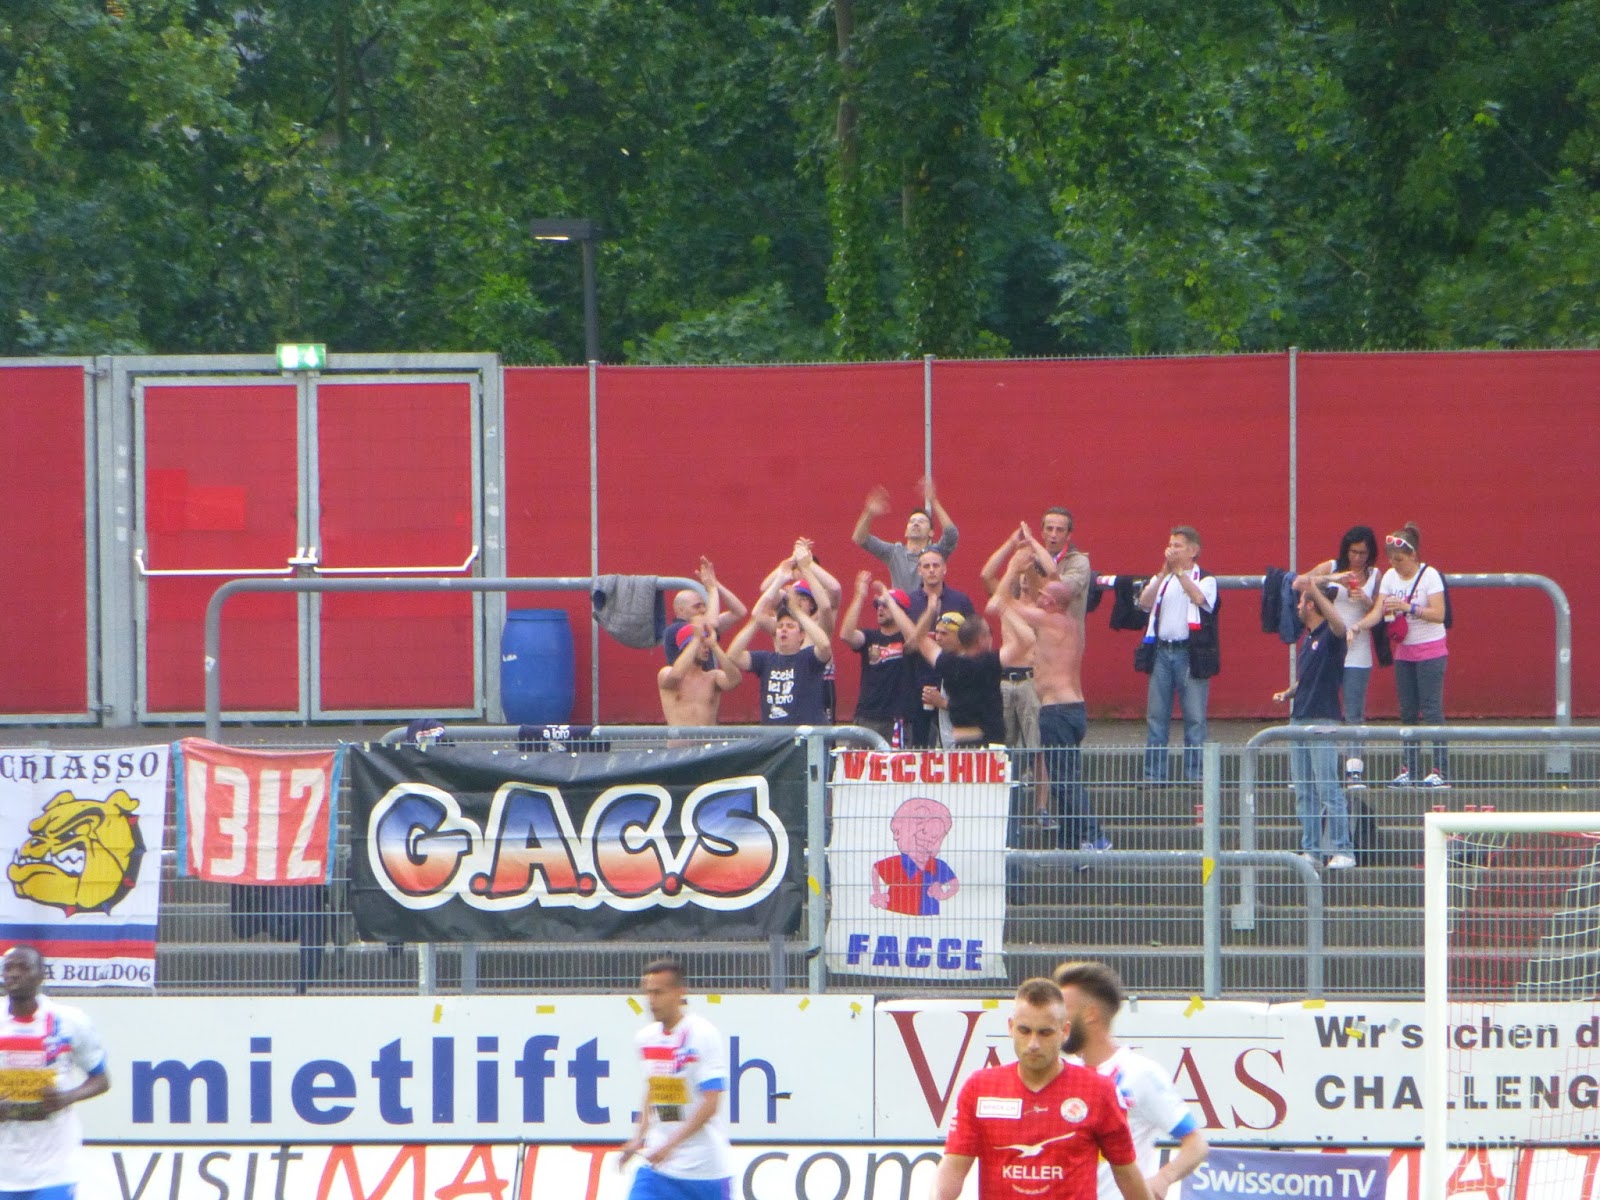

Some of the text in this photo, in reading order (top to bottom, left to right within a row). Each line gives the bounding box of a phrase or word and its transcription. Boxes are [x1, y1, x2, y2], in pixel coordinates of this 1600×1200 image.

[842, 751, 1006, 783] VECCHIE
[187, 758, 326, 880] 1312
[846, 934, 983, 971] FACCE
[1314, 1015, 1387, 1048] Wir
[1401, 1016, 1558, 1049] schen
[132, 1035, 777, 1125] mietlift.h
[1002, 1164, 1064, 1180] KELLER
[1192, 1162, 1377, 1198] Swisscom TV
